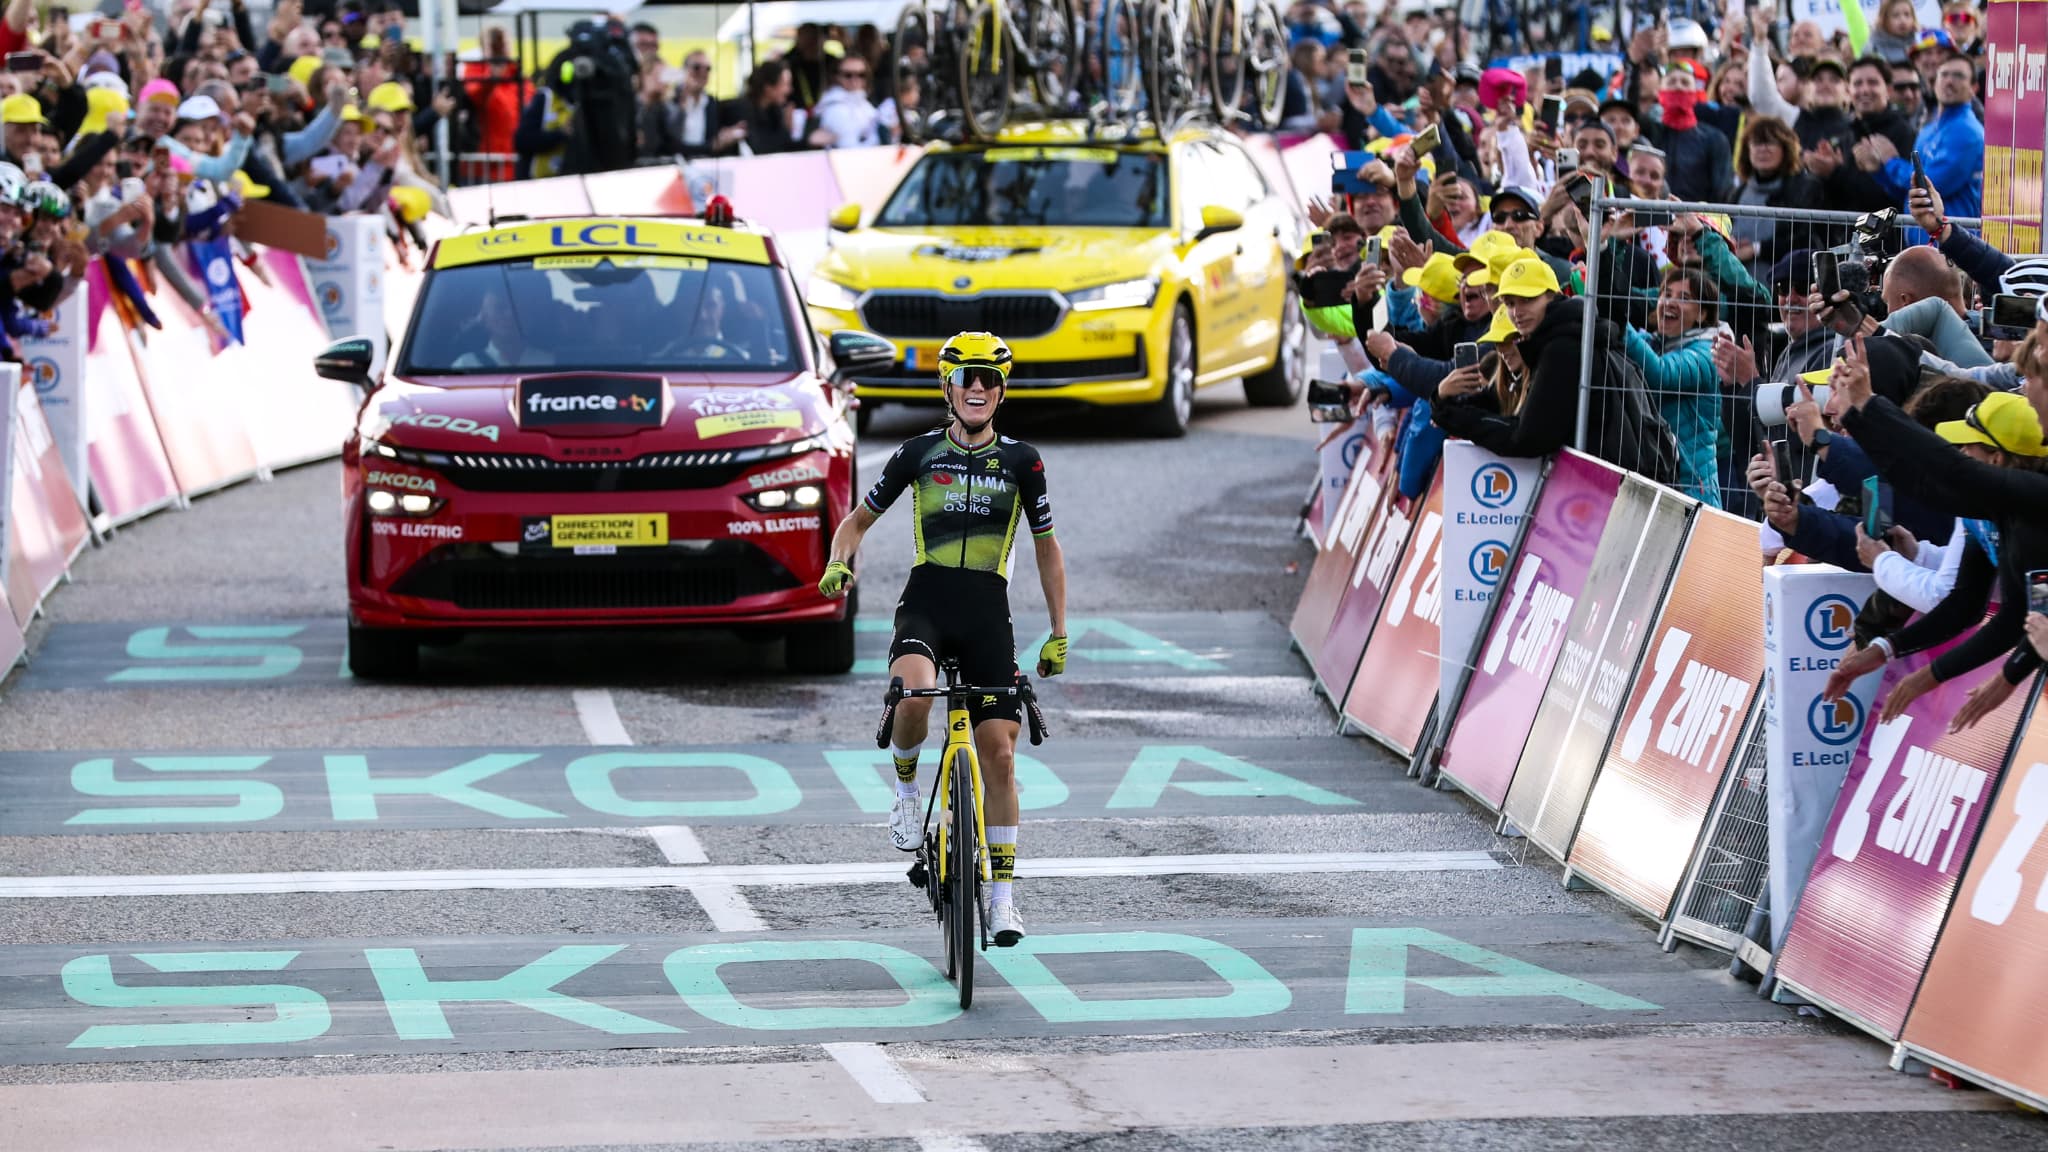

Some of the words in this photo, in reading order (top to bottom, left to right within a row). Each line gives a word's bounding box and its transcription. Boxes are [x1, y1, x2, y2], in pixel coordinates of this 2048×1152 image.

[482, 232, 526, 247] LCL
[550, 223, 658, 248] LCL
[685, 232, 730, 246] LCL
[367, 471, 436, 493] SKODA
[748, 467, 823, 489] SKODA
[957, 473, 1007, 493] VISMA
[945, 490, 992, 505] lease
[401, 522, 464, 540] ELECTRIC
[556, 519, 634, 529] DIRECTION
[648, 519, 658, 538] 1
[726, 520, 763, 535] 100%
[764, 516, 820, 533] ELECTRIC
[1508, 580, 1575, 681] ZWIFT
[1656, 659, 1751, 774] ZWIFT
[1875, 744, 1988, 874] ZWIFT
[60, 927, 1665, 1049] SKODA
